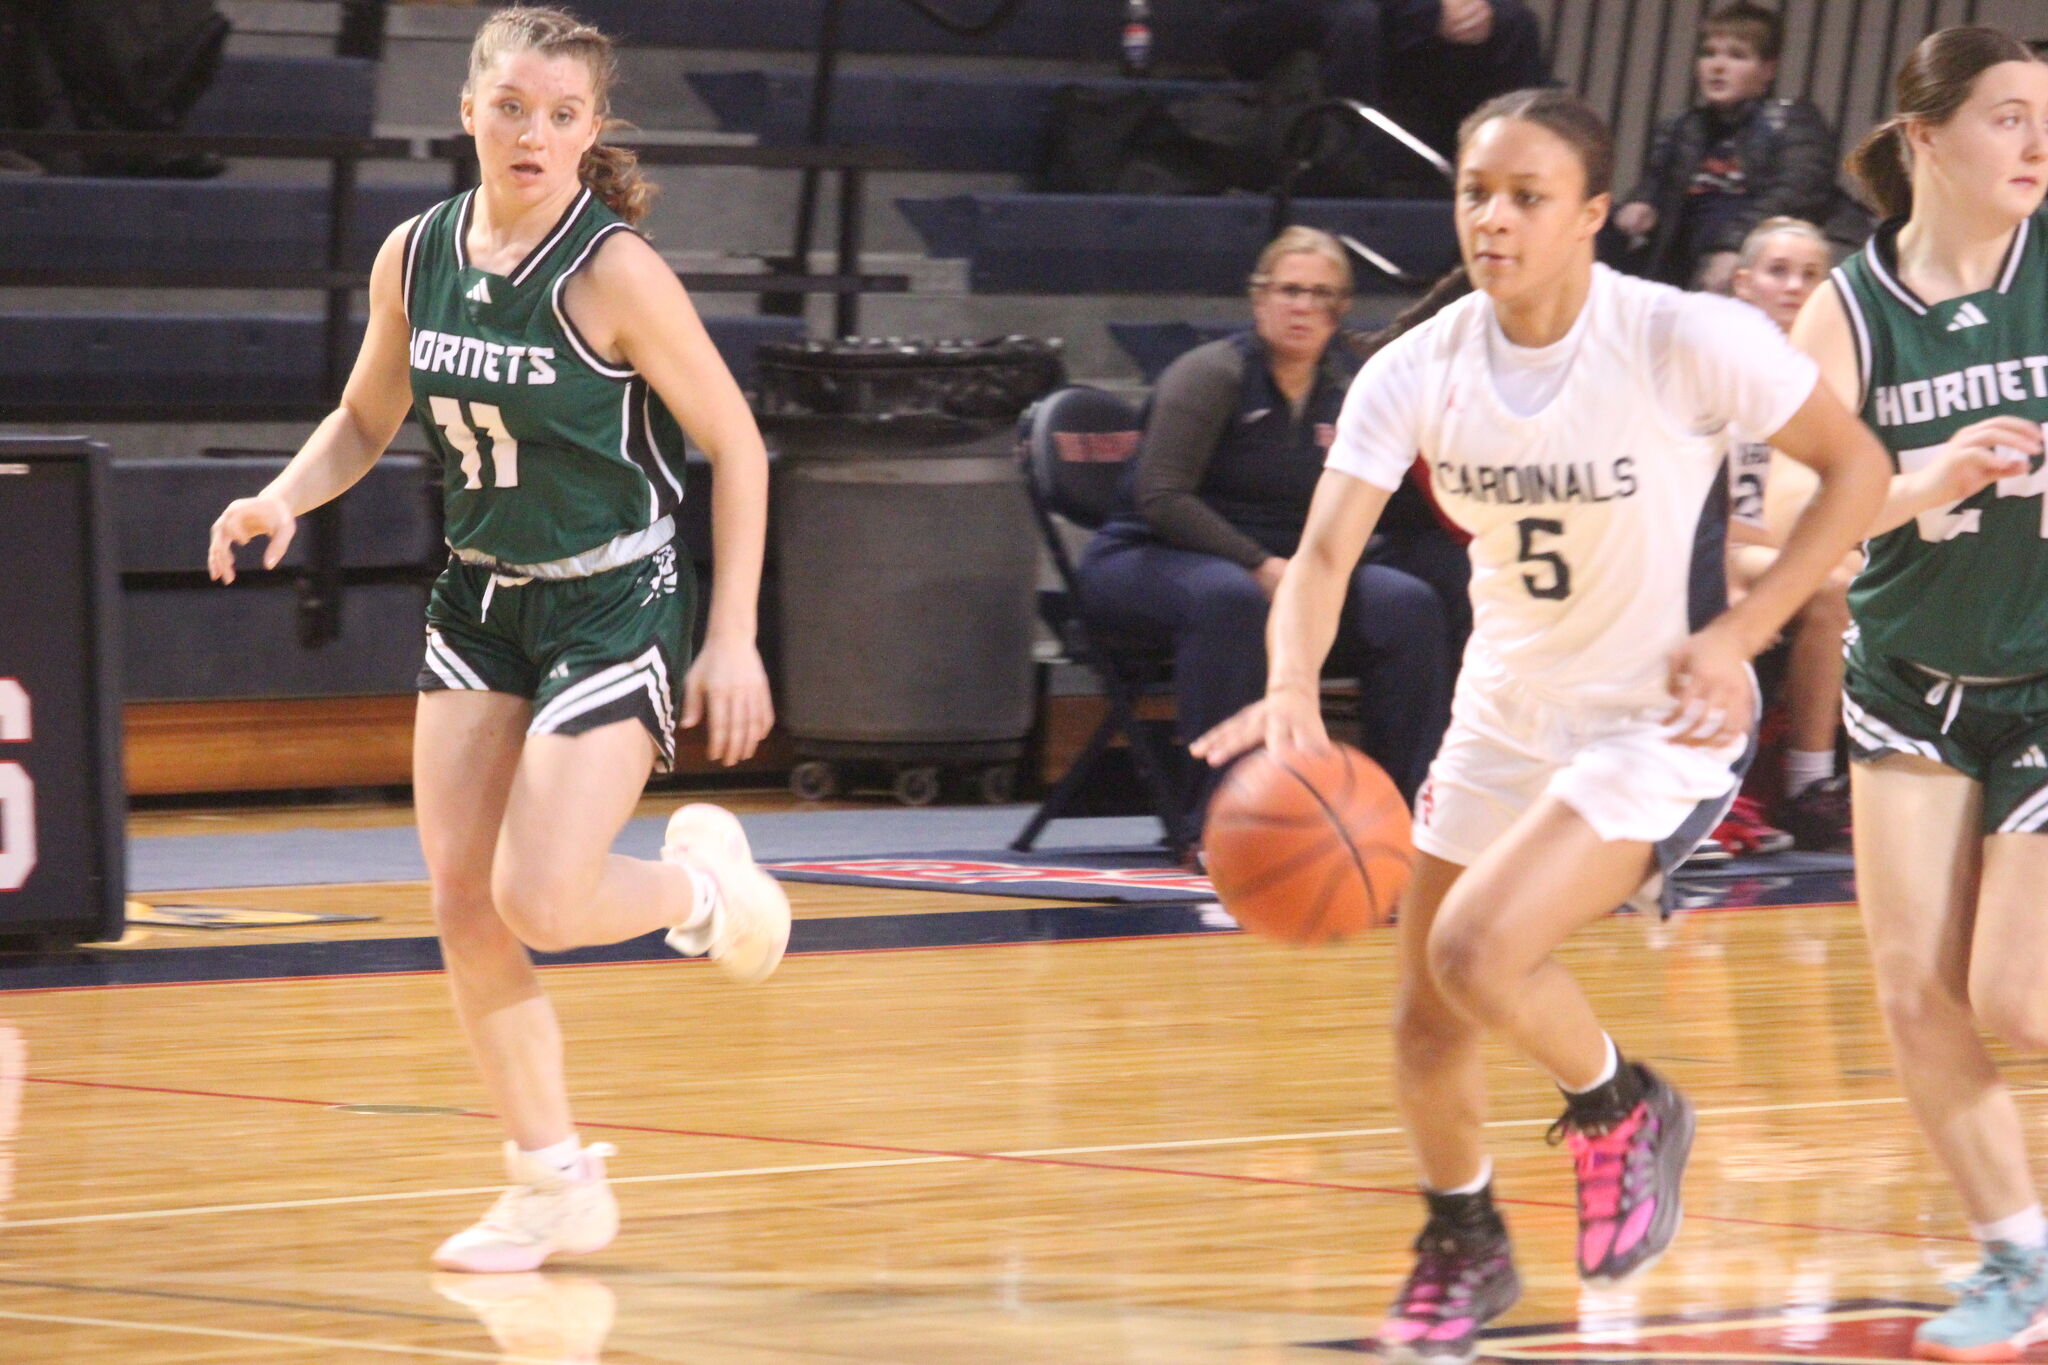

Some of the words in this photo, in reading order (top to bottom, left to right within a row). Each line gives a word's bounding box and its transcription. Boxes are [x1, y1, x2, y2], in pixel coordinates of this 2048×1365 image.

[428, 395, 518, 490] 11
[1437, 457, 1637, 504] CARDINALS
[1517, 517, 1571, 601] 5
